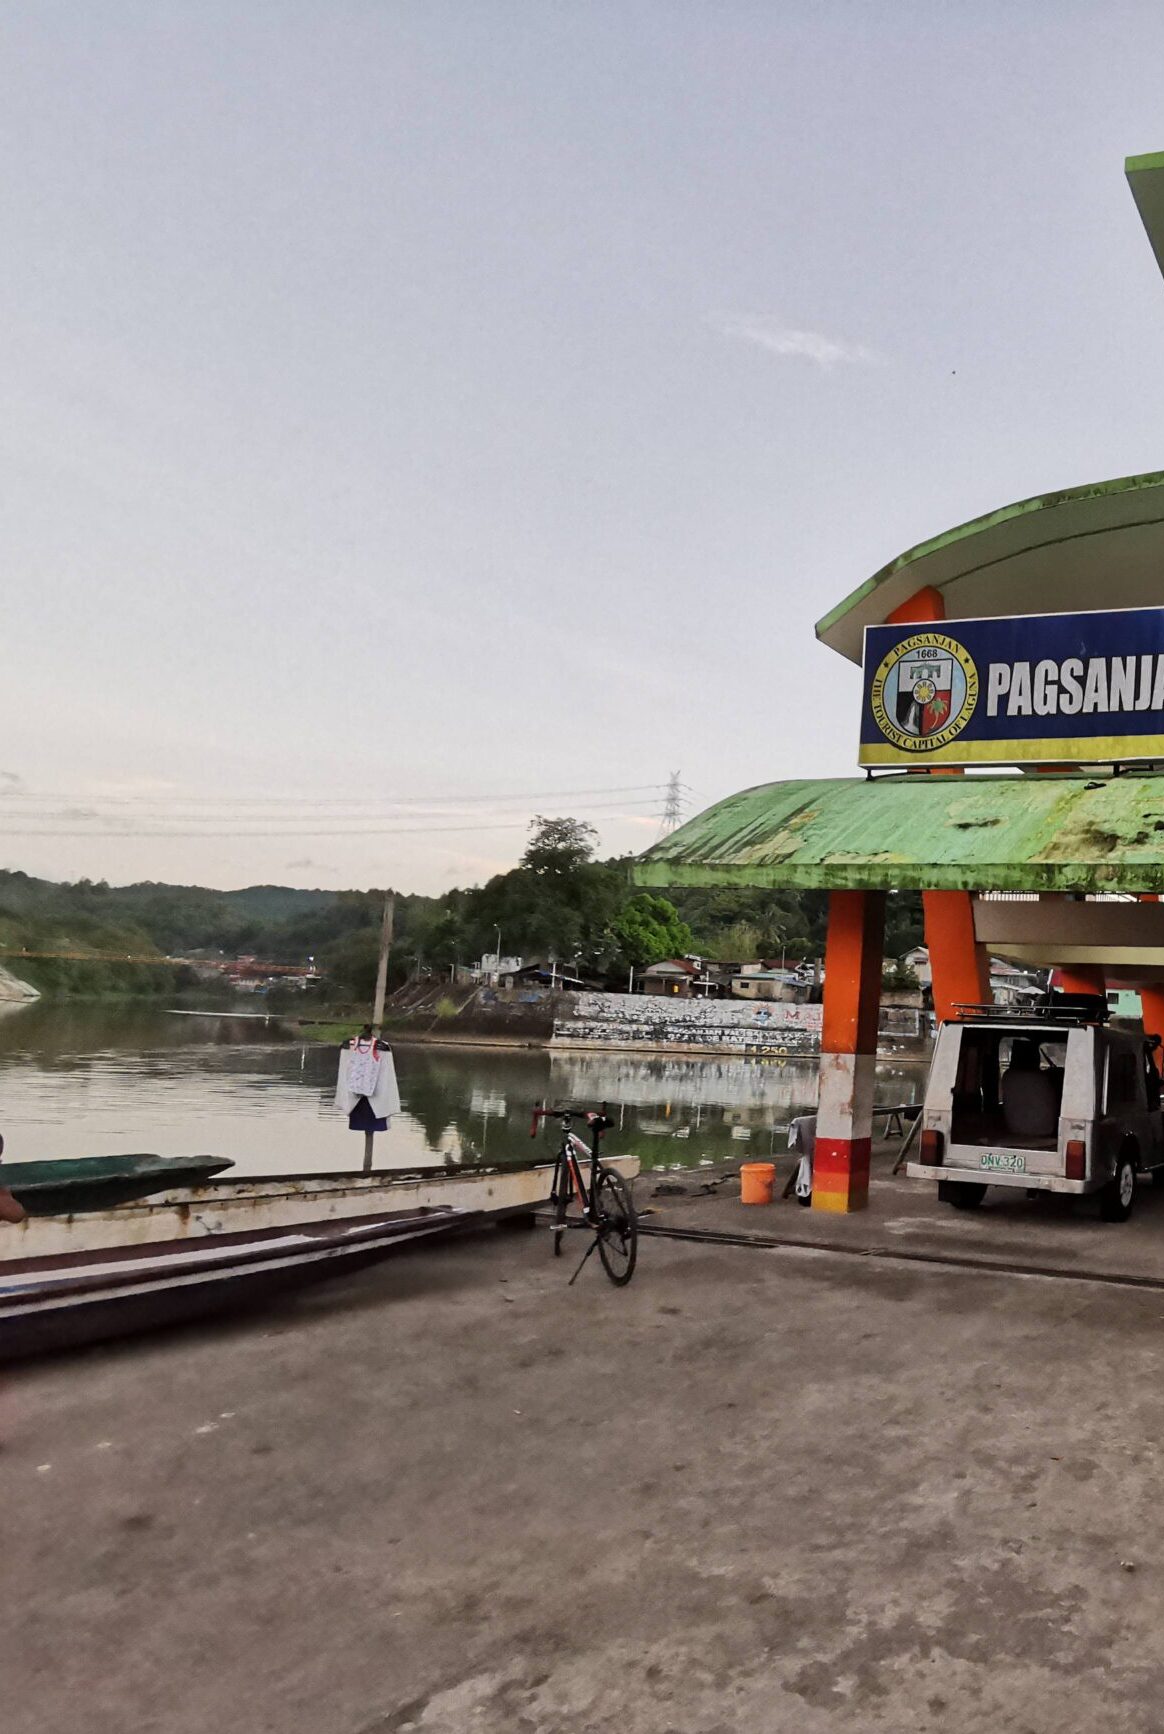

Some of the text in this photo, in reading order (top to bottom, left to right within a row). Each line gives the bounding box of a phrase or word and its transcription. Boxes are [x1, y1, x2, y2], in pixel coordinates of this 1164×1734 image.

[893, 635, 961, 656] PAGSANJAN
[916, 649, 938, 659] 1668
[873, 702, 902, 746] TOURIST
[903, 735, 948, 749] CAPITAL
[948, 722, 964, 737] OF
[960, 672, 978, 722] LAGUNA
[1003, 1156, 1023, 1169] 320
